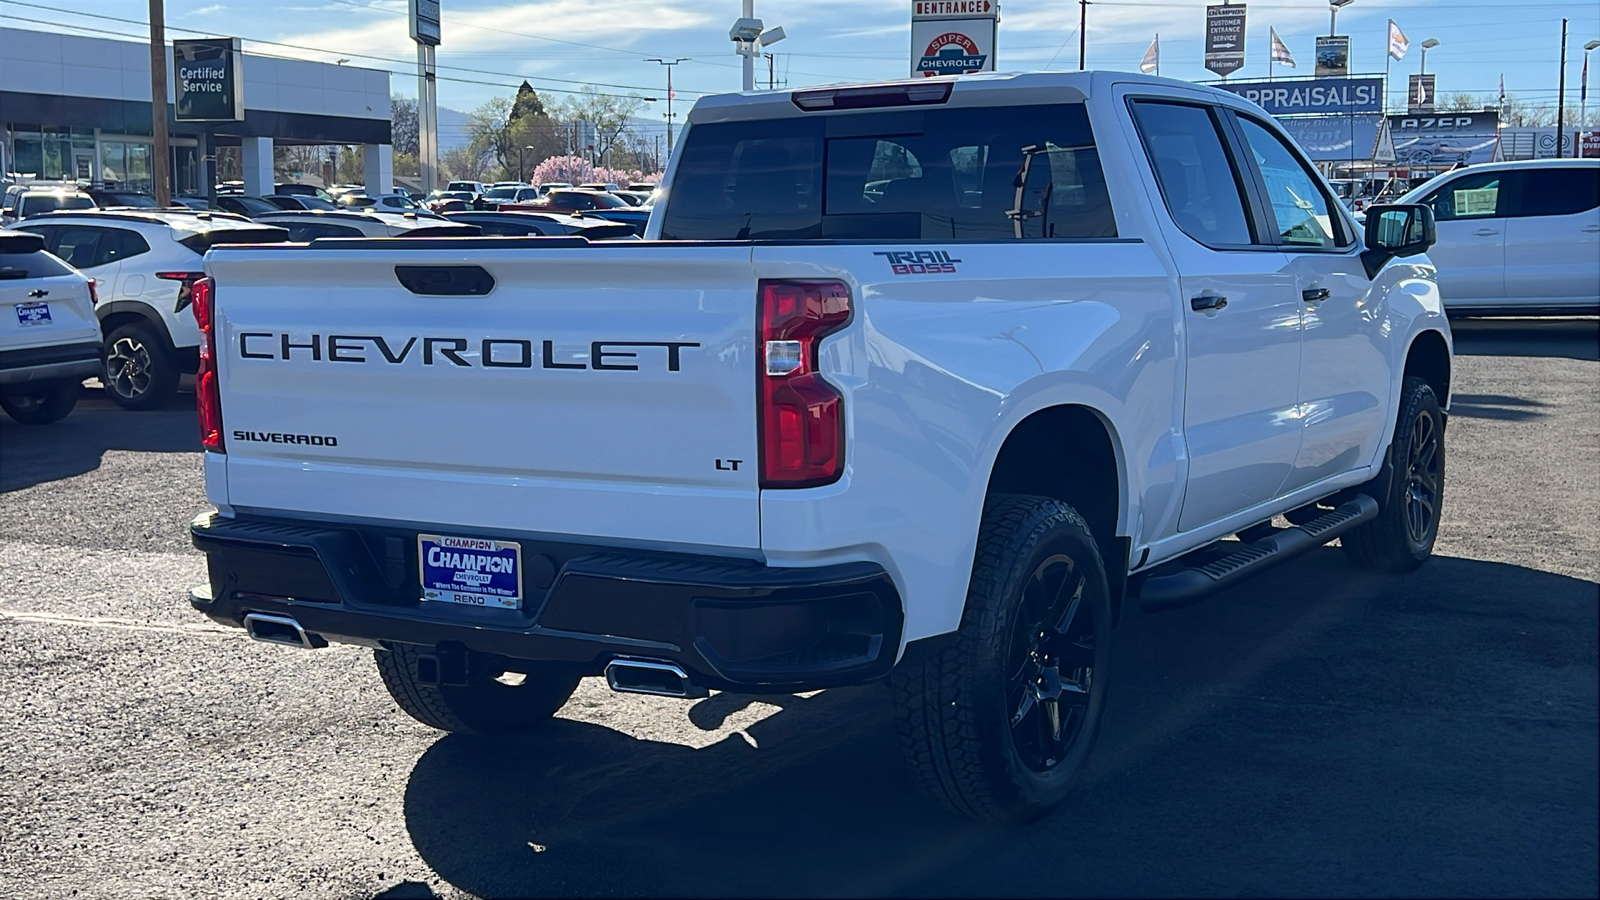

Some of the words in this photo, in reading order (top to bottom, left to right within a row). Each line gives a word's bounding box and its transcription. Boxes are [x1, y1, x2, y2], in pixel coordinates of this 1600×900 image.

[924, 1, 982, 14] ENTRANCE
[1210, 19, 1241, 27] CUSTOMER
[1210, 26, 1241, 34] ENTRANCE
[931, 34, 972, 50] SUPER
[921, 59, 982, 68] CHEVROLET
[1210, 60, 1239, 68] Welcome!
[180, 67, 225, 79] Certified
[183, 80, 222, 92] Service
[1280, 119, 1311, 128] elley
[1313, 119, 1340, 127] Blue
[1342, 118, 1373, 127] Book
[872, 250, 963, 264] TRAIL
[891, 263, 957, 275] BOSS
[18, 307, 48, 316] CHAMPION
[239, 331, 702, 373] CHEVROLET
[232, 429, 338, 447] SILVERADO
[714, 458, 743, 472] LT
[444, 537, 492, 550] CHAMPION
[427, 546, 514, 574] CHAMPION
[455, 573, 489, 583] CHEVROLET
[453, 594, 485, 605] RENO
